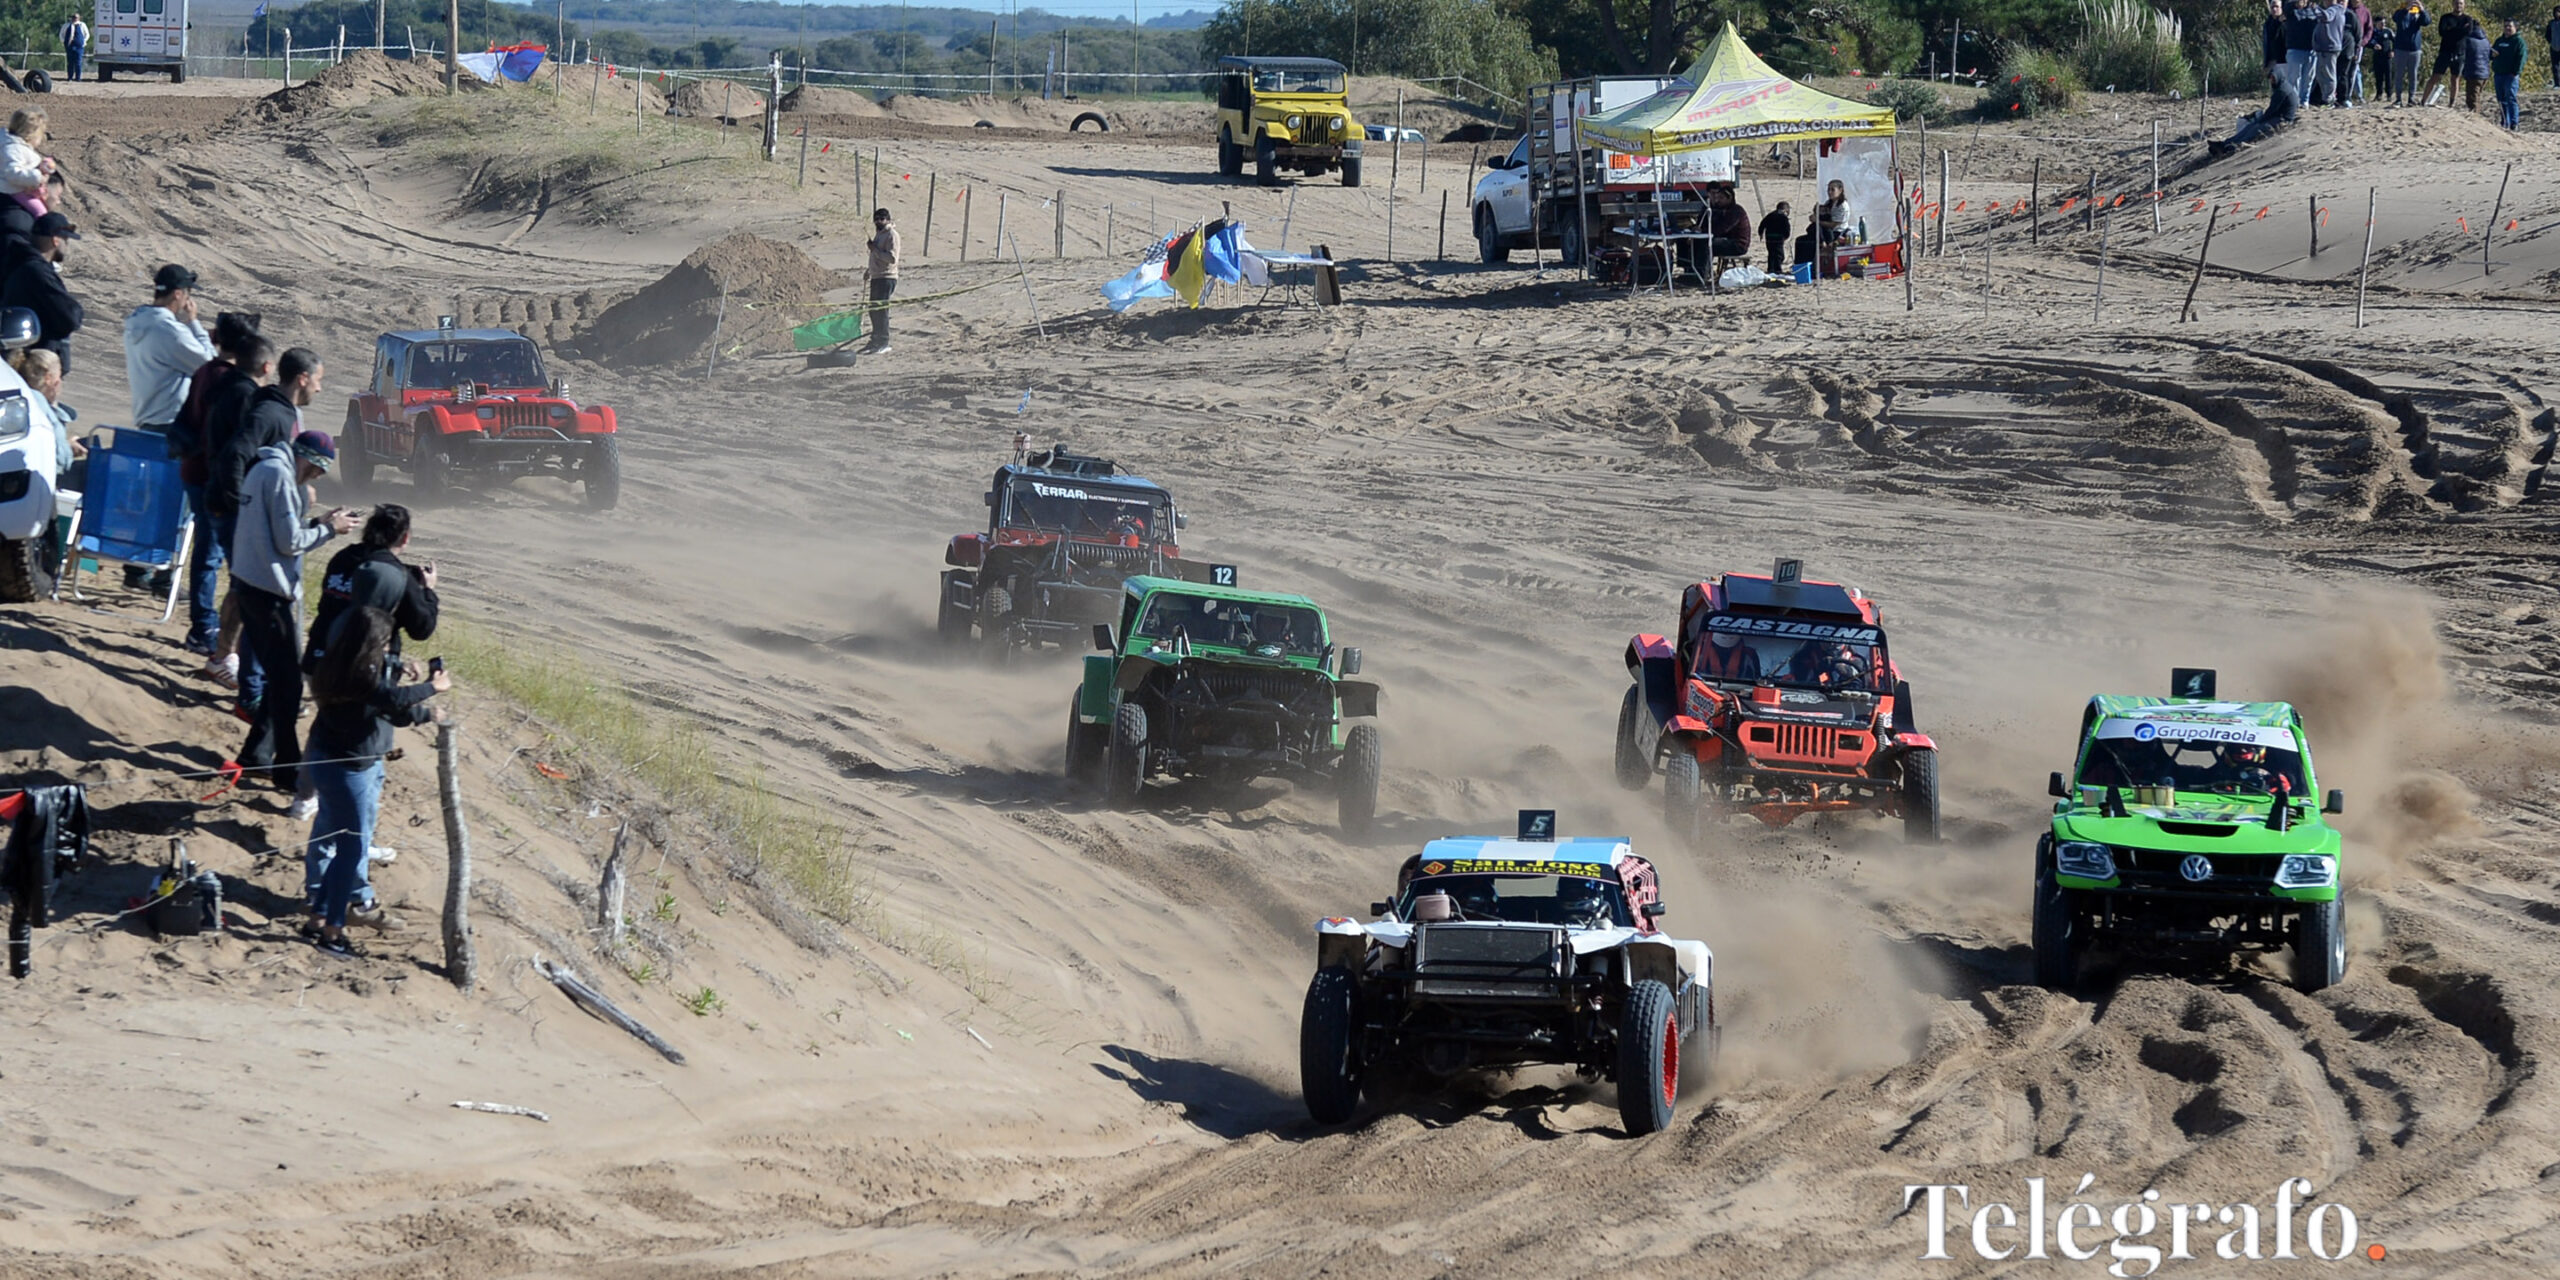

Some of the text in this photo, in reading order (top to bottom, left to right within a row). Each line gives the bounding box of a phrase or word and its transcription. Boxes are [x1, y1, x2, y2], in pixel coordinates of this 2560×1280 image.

[1687, 80, 1792, 122] MAROTE
[442, 317, 451, 327] 7
[1032, 482, 1087, 500] FERRARI
[1215, 567, 1232, 584] 12
[1781, 563, 1796, 578] 10
[1708, 616, 1879, 641] CASTAGNA
[2188, 673, 2204, 690] 4
[2157, 726, 2257, 743] GrupoIraola
[1529, 815, 1550, 832] 5
[1452, 859, 1516, 868] San
[1452, 866, 1601, 878] SUPERMERCADOS
